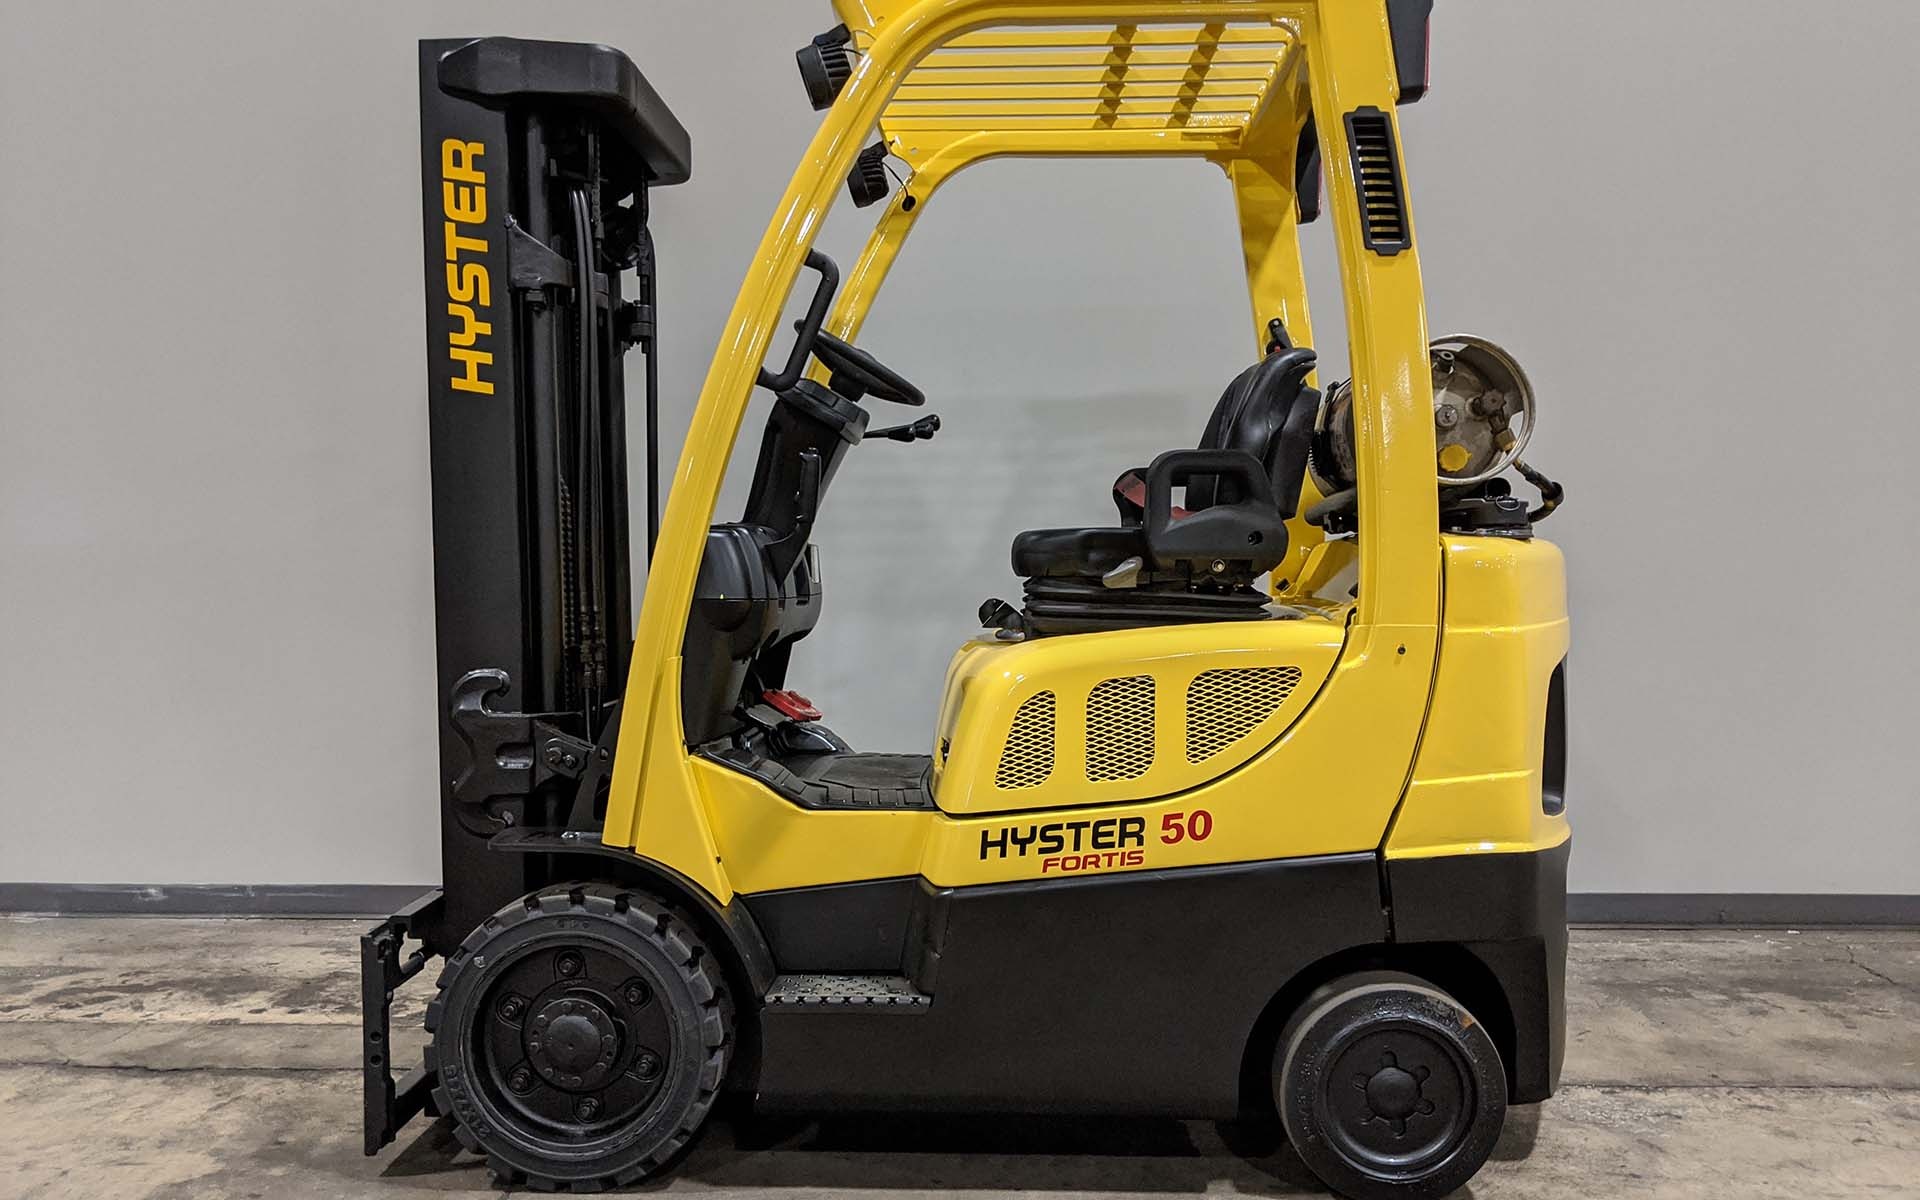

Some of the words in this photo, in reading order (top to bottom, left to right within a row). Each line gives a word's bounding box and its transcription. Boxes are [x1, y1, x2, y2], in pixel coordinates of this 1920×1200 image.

[442, 138, 494, 395] HYSTER
[980, 817, 1145, 859] HYSTER
[1160, 810, 1212, 844] 50
[1042, 850, 1145, 873] FORTIS
